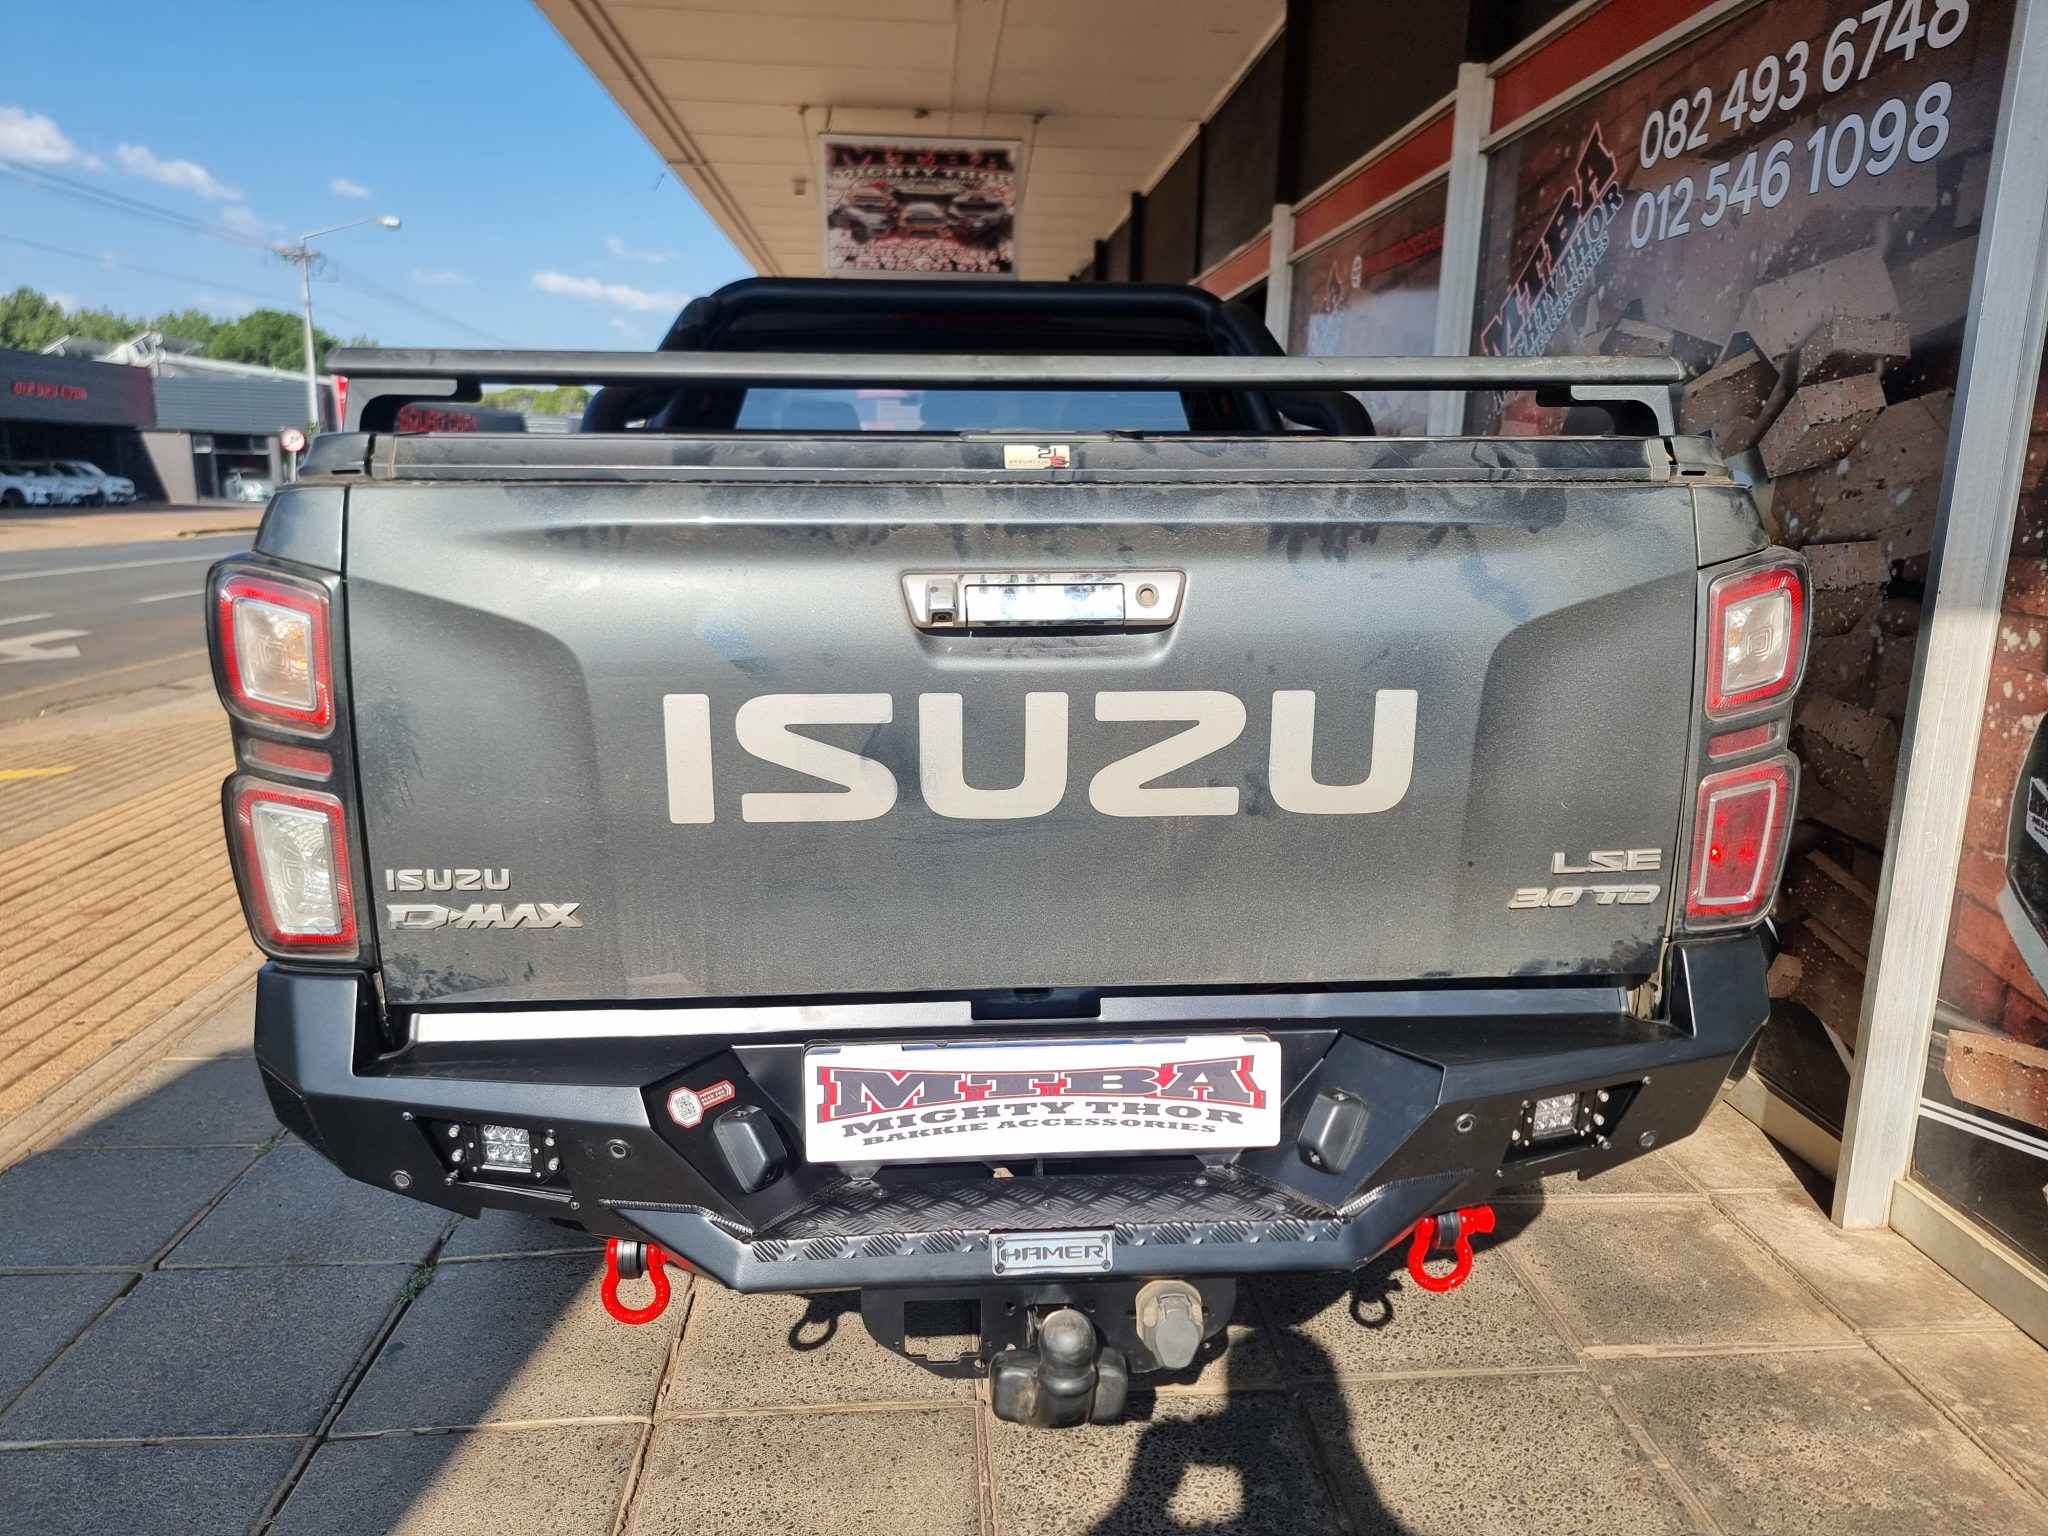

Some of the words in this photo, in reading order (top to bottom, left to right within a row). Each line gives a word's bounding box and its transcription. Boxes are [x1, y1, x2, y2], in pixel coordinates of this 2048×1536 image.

[1640, 86, 1713, 169] 082
[1720, 41, 1810, 131] 493
[1822, 0, 1970, 93] 6748
[829, 144, 1015, 171] MTBA
[831, 167, 936, 180] MIGHTY
[1630, 176, 1694, 249] 012
[1700, 138, 1794, 228] 546
[1807, 81, 1952, 195] 1098
[1481, 121, 1618, 356] MTBA
[1560, 181, 1624, 288] THOR
[662, 689, 1418, 825] ISUZU
[1552, 848, 1662, 875] LSE
[385, 868, 511, 892] ISUZU
[386, 902, 584, 930] D-MAX
[816, 1054, 1267, 1124] MTBA
[841, 1101, 1075, 1138] MIGHTY
[1085, 1101, 1244, 1125] THOR
[862, 1122, 989, 1146] BAKKIE
[997, 1118, 1217, 1133] ACCESSORIES
[1000, 1245, 1105, 1262] HAMER
